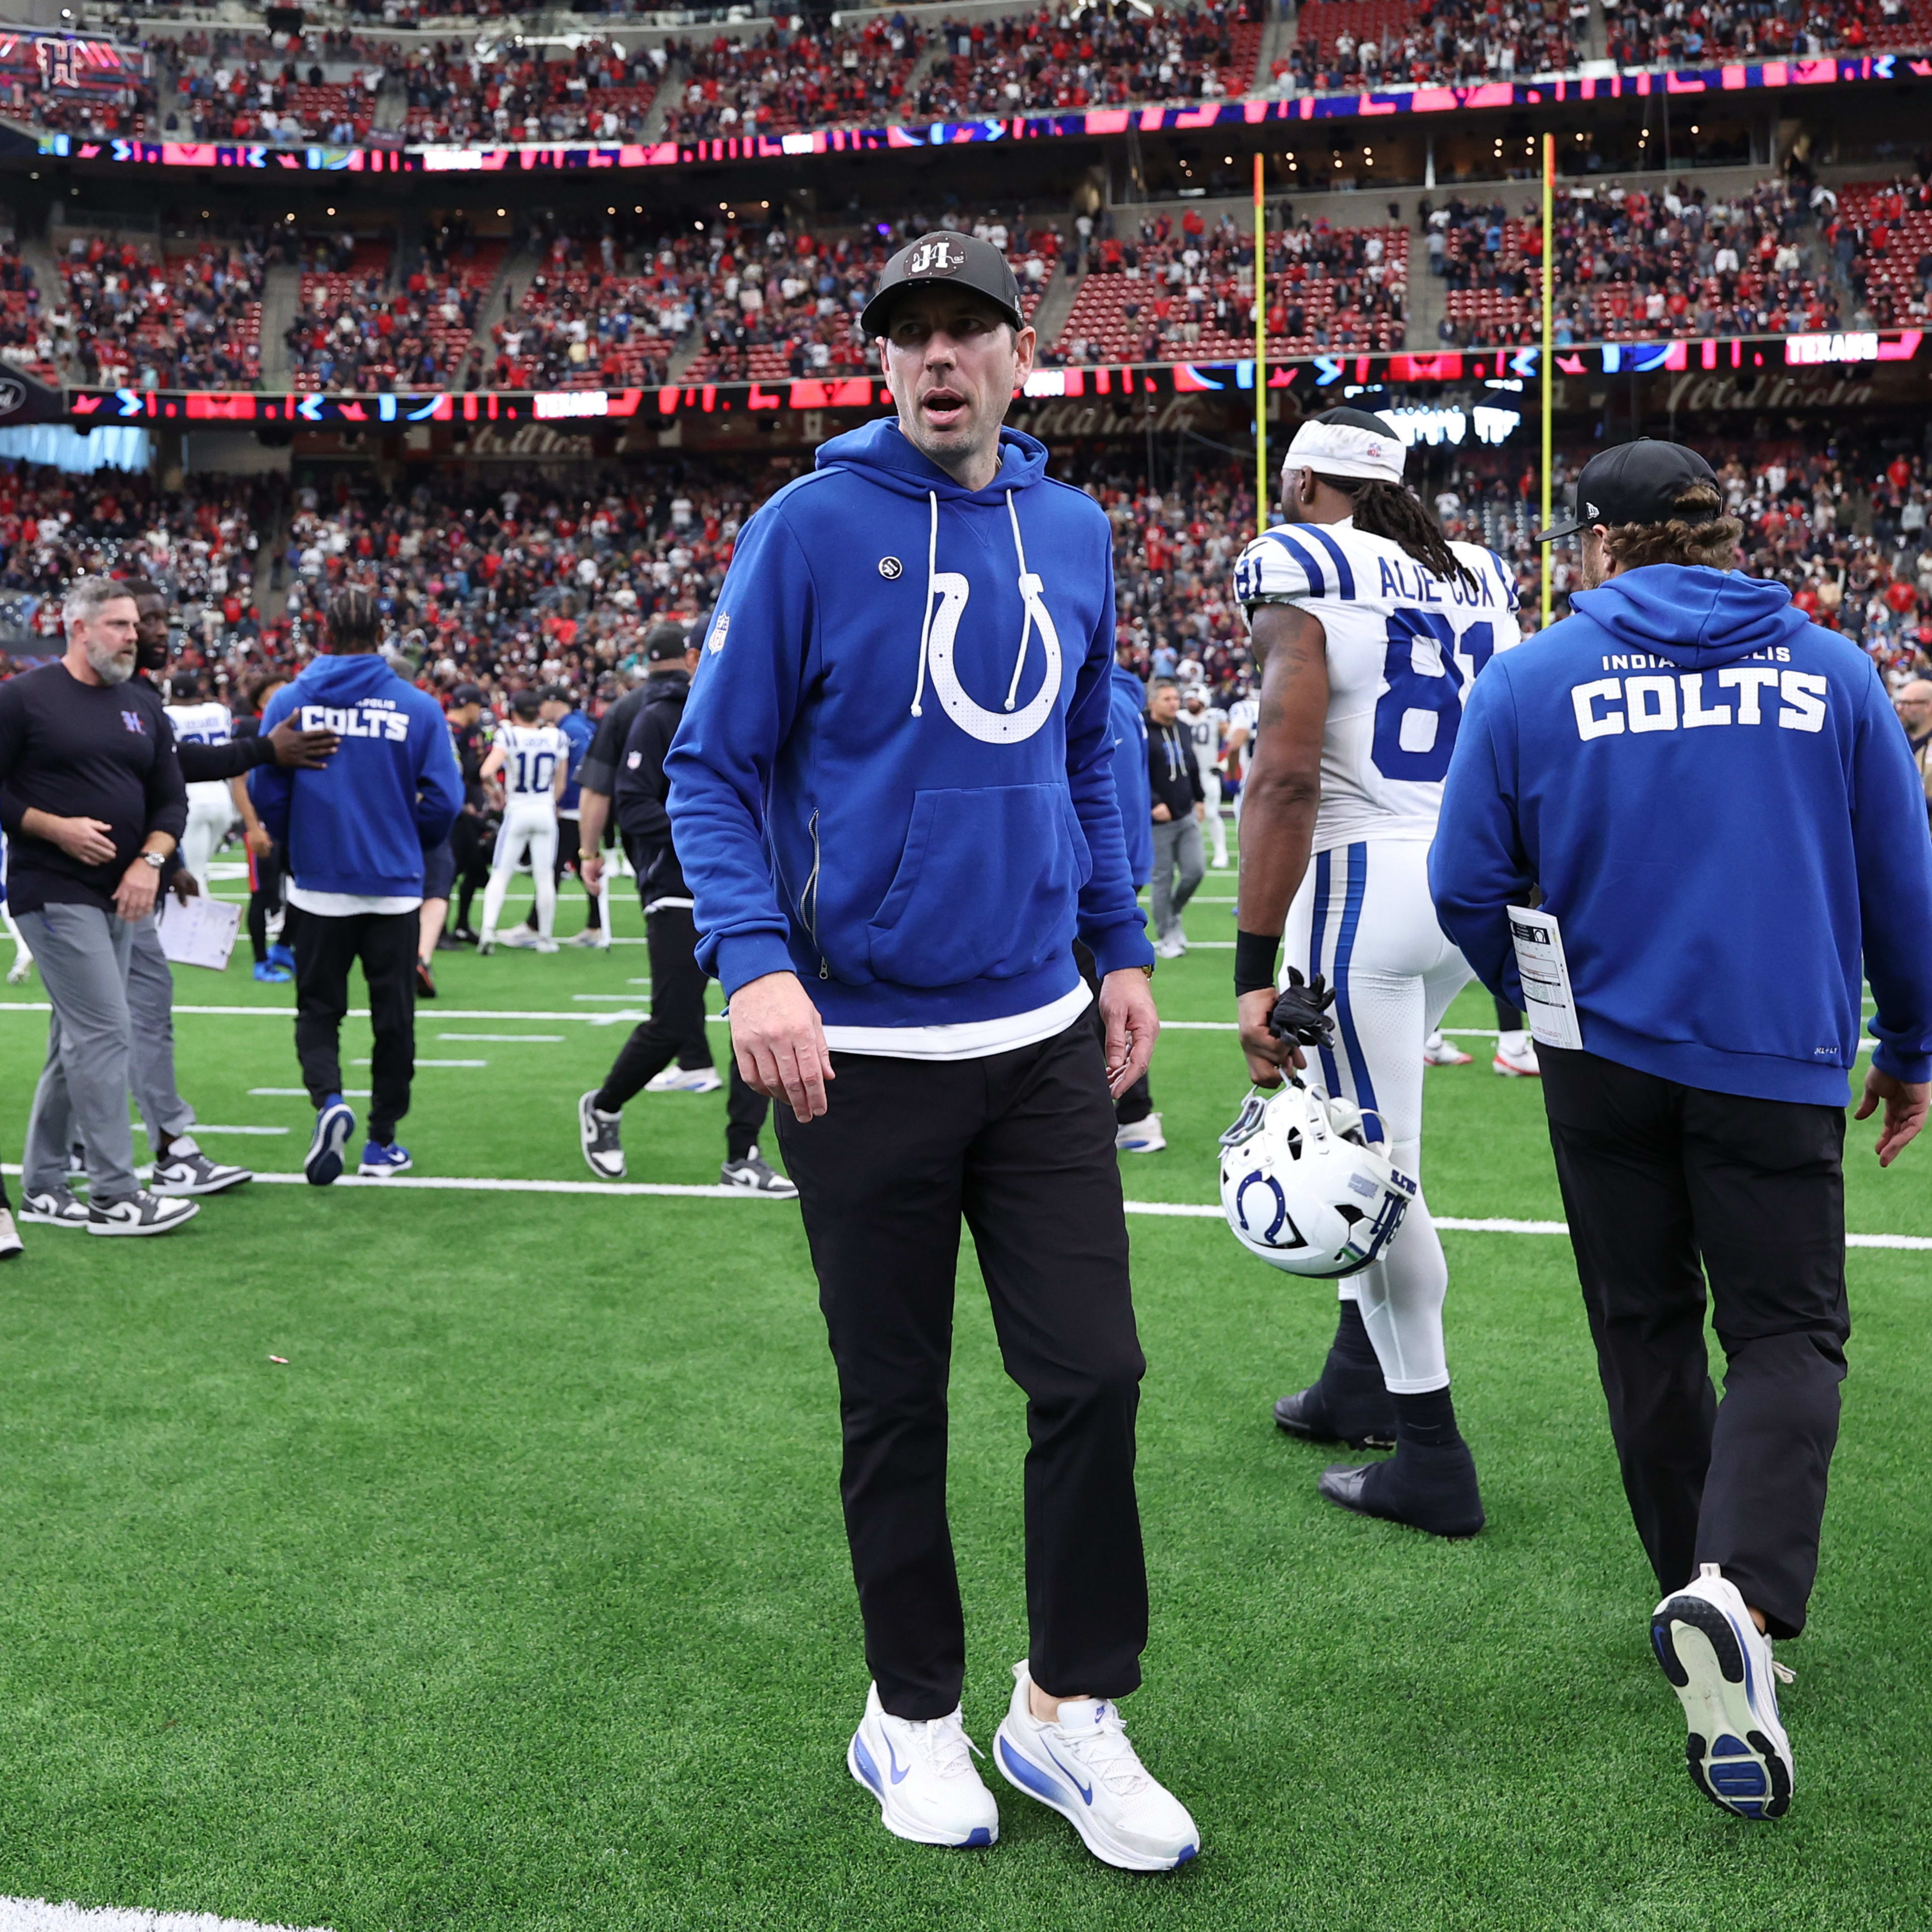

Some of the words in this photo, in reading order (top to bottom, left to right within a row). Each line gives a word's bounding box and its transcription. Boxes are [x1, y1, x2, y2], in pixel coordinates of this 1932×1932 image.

[1787, 333, 1878, 362] TEXANS
[1602, 647, 1791, 671] INDIALIS
[1571, 667, 1827, 742] COLTS
[301, 705, 410, 742] COLTS
[514, 752, 555, 793] 10
